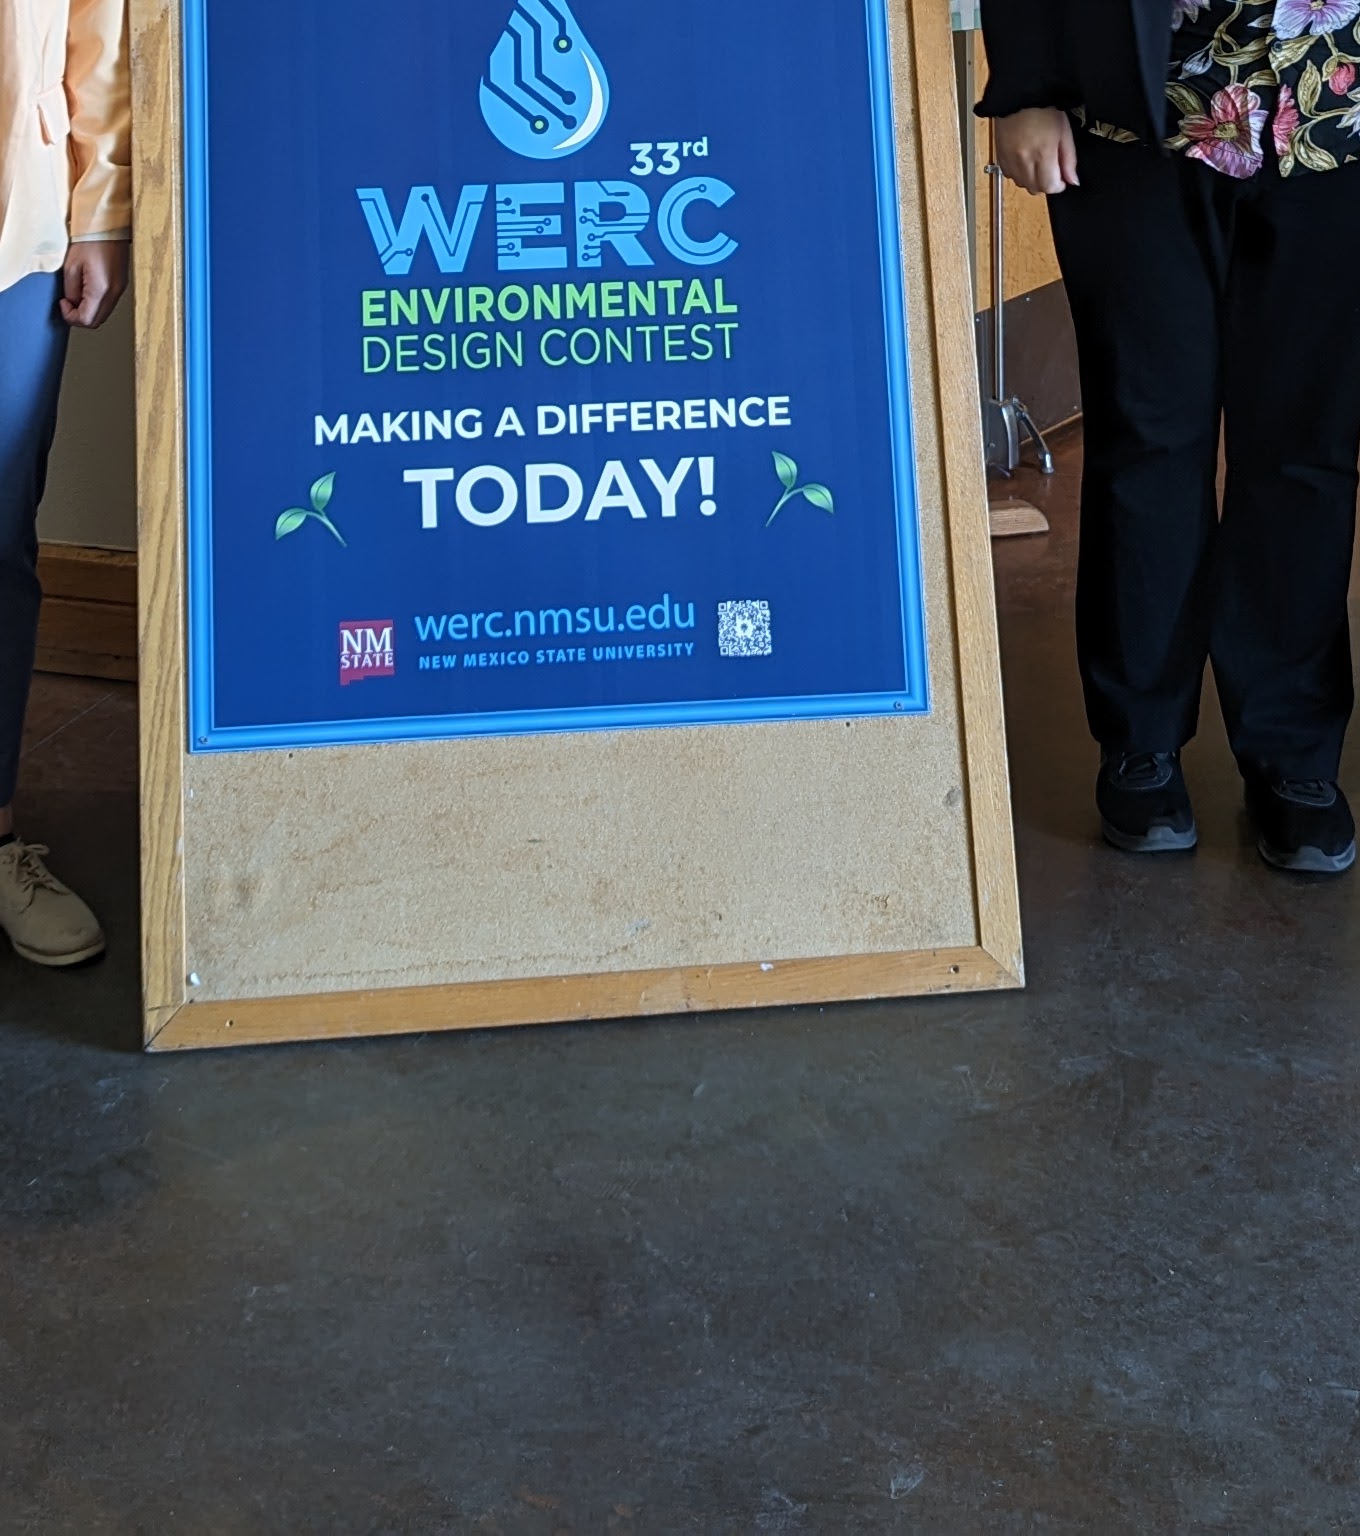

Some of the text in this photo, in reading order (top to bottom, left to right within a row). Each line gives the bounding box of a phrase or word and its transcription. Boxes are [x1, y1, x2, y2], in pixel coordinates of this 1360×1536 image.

[629, 136, 710, 177] 33rd
[356, 176, 739, 276] WERC
[362, 278, 738, 328] ENVIRONMENTAL
[363, 321, 739, 374] DESIGN CONTEST
[314, 396, 792, 446] MAKING A DIFFERENCE
[403, 455, 718, 529] TODAY!
[340, 627, 393, 654] NM
[414, 593, 696, 642] werc.nmsu.edu
[340, 652, 394, 670] STATE
[419, 642, 695, 670] NEW MEXICO STATE UNIVERSITY
